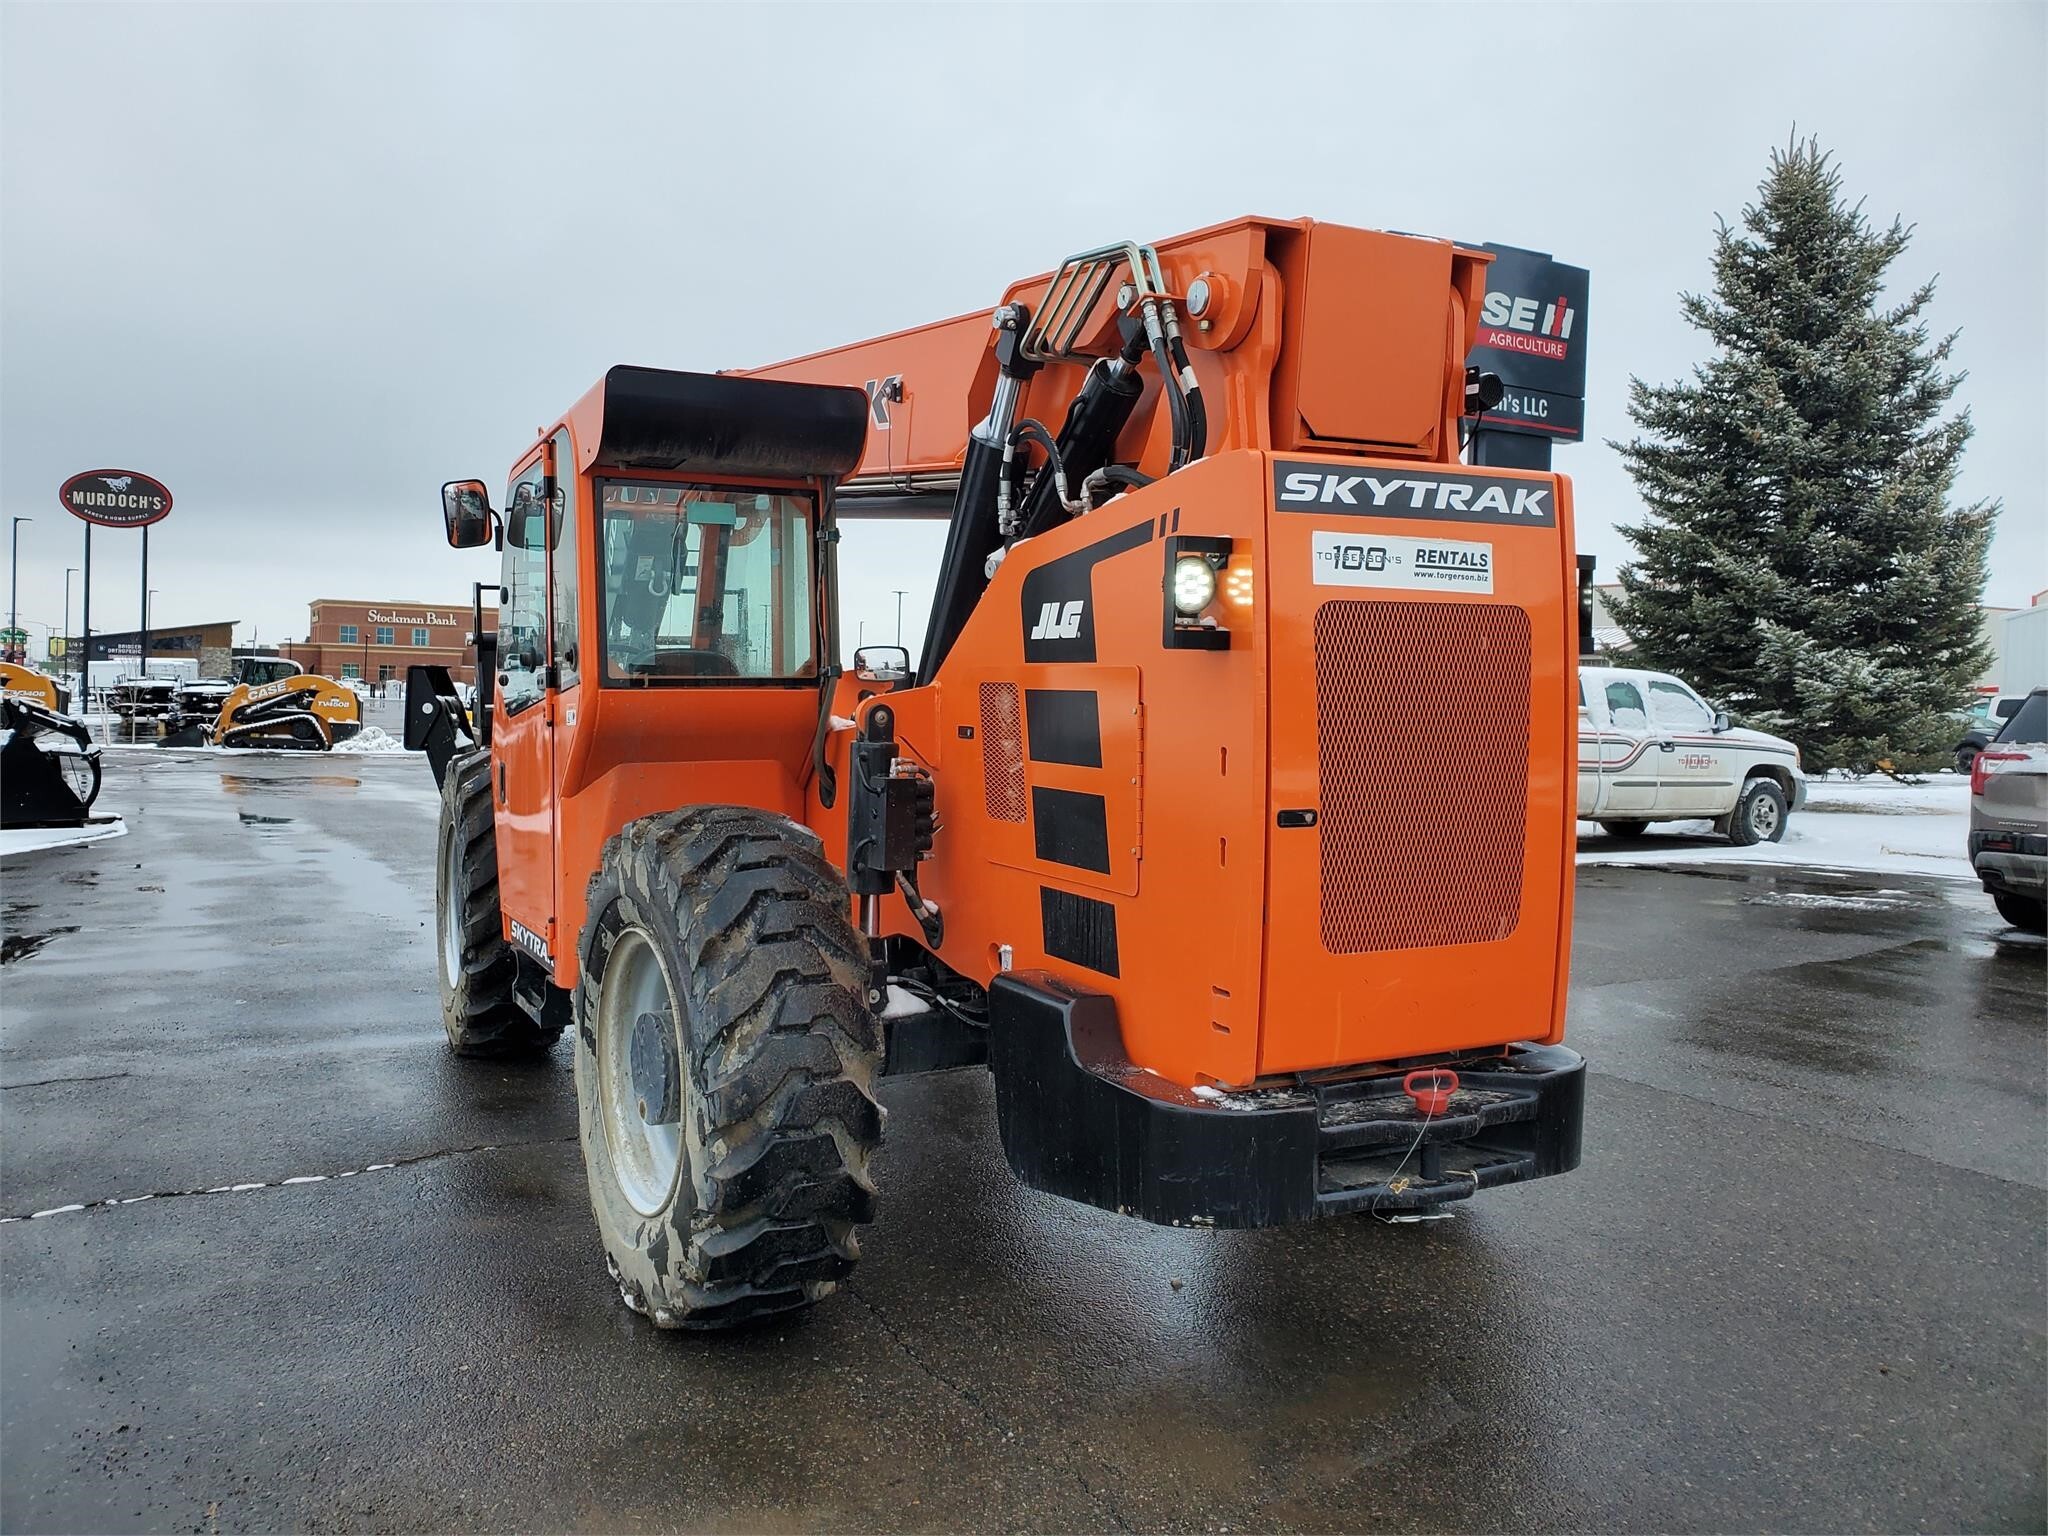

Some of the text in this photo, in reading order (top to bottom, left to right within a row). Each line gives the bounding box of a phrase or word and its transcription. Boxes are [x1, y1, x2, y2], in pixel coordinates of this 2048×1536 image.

[1480, 292, 1539, 331] SE
[1489, 332, 1564, 357] AGRICULTURE
[1491, 394, 1548, 418] n's LLC
[72, 491, 161, 510] MURDOCH'S
[1280, 472, 1549, 516] SKYTRAK
[1333, 545, 1387, 572] 100
[1415, 549, 1488, 568] RENTALS
[1413, 571, 1488, 582] www.torgerson.biz
[367, 609, 457, 626] Stockman Bank
[1031, 600, 1084, 640] JLG
[247, 682, 288, 701] CASE
